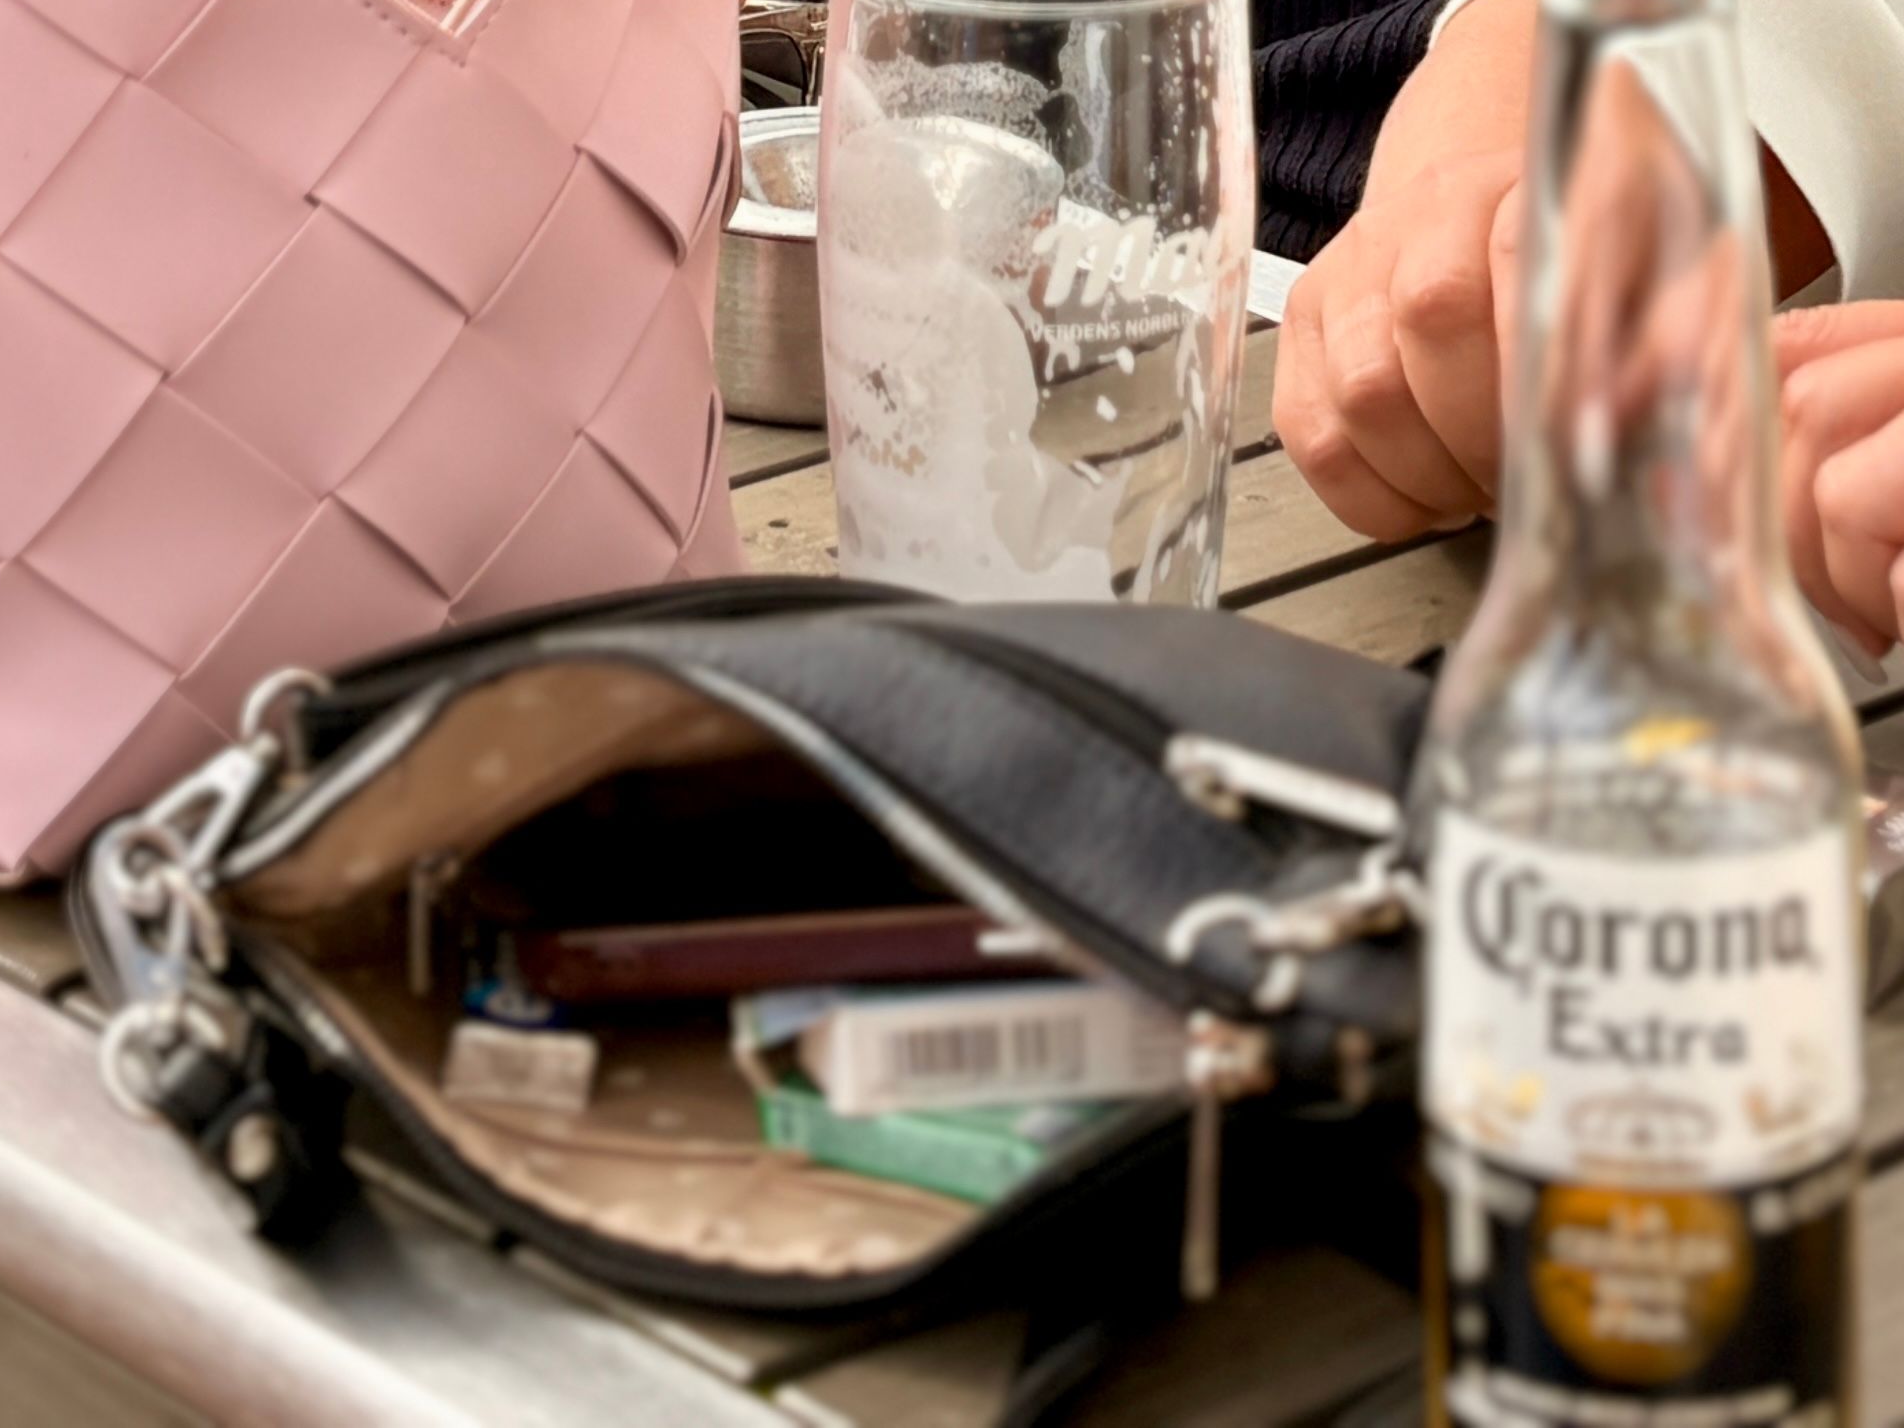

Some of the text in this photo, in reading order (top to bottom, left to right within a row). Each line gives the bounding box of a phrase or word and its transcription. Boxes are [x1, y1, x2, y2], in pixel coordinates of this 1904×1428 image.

[1031, 320, 1121, 343] VERDENS
[1459, 856, 1824, 998] Corona
[1544, 984, 1748, 1070] Extra
